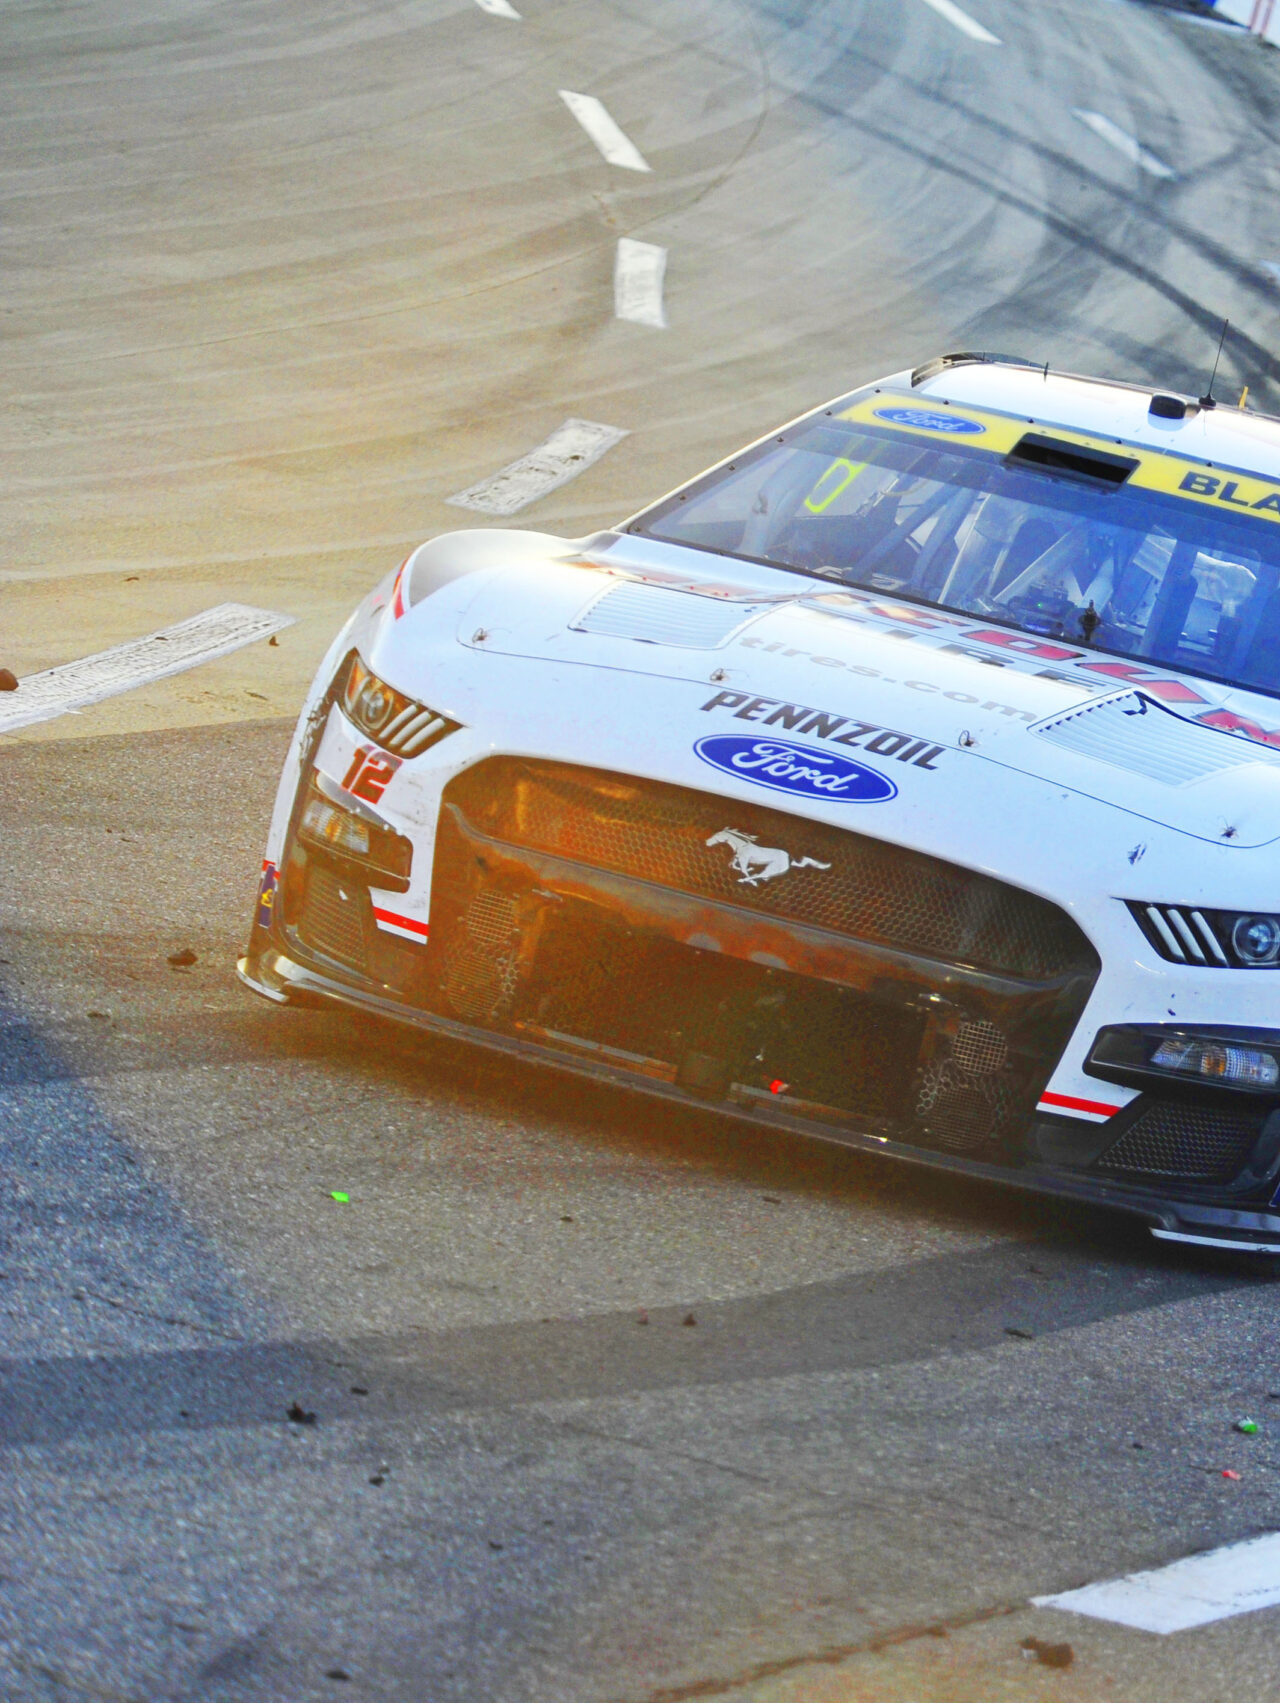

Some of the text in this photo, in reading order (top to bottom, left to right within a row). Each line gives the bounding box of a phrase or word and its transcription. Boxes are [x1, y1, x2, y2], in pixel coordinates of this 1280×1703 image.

[738, 636, 1038, 722] tires.com
[699, 690, 946, 771] PENNZOIL
[340, 744, 404, 805] 12
